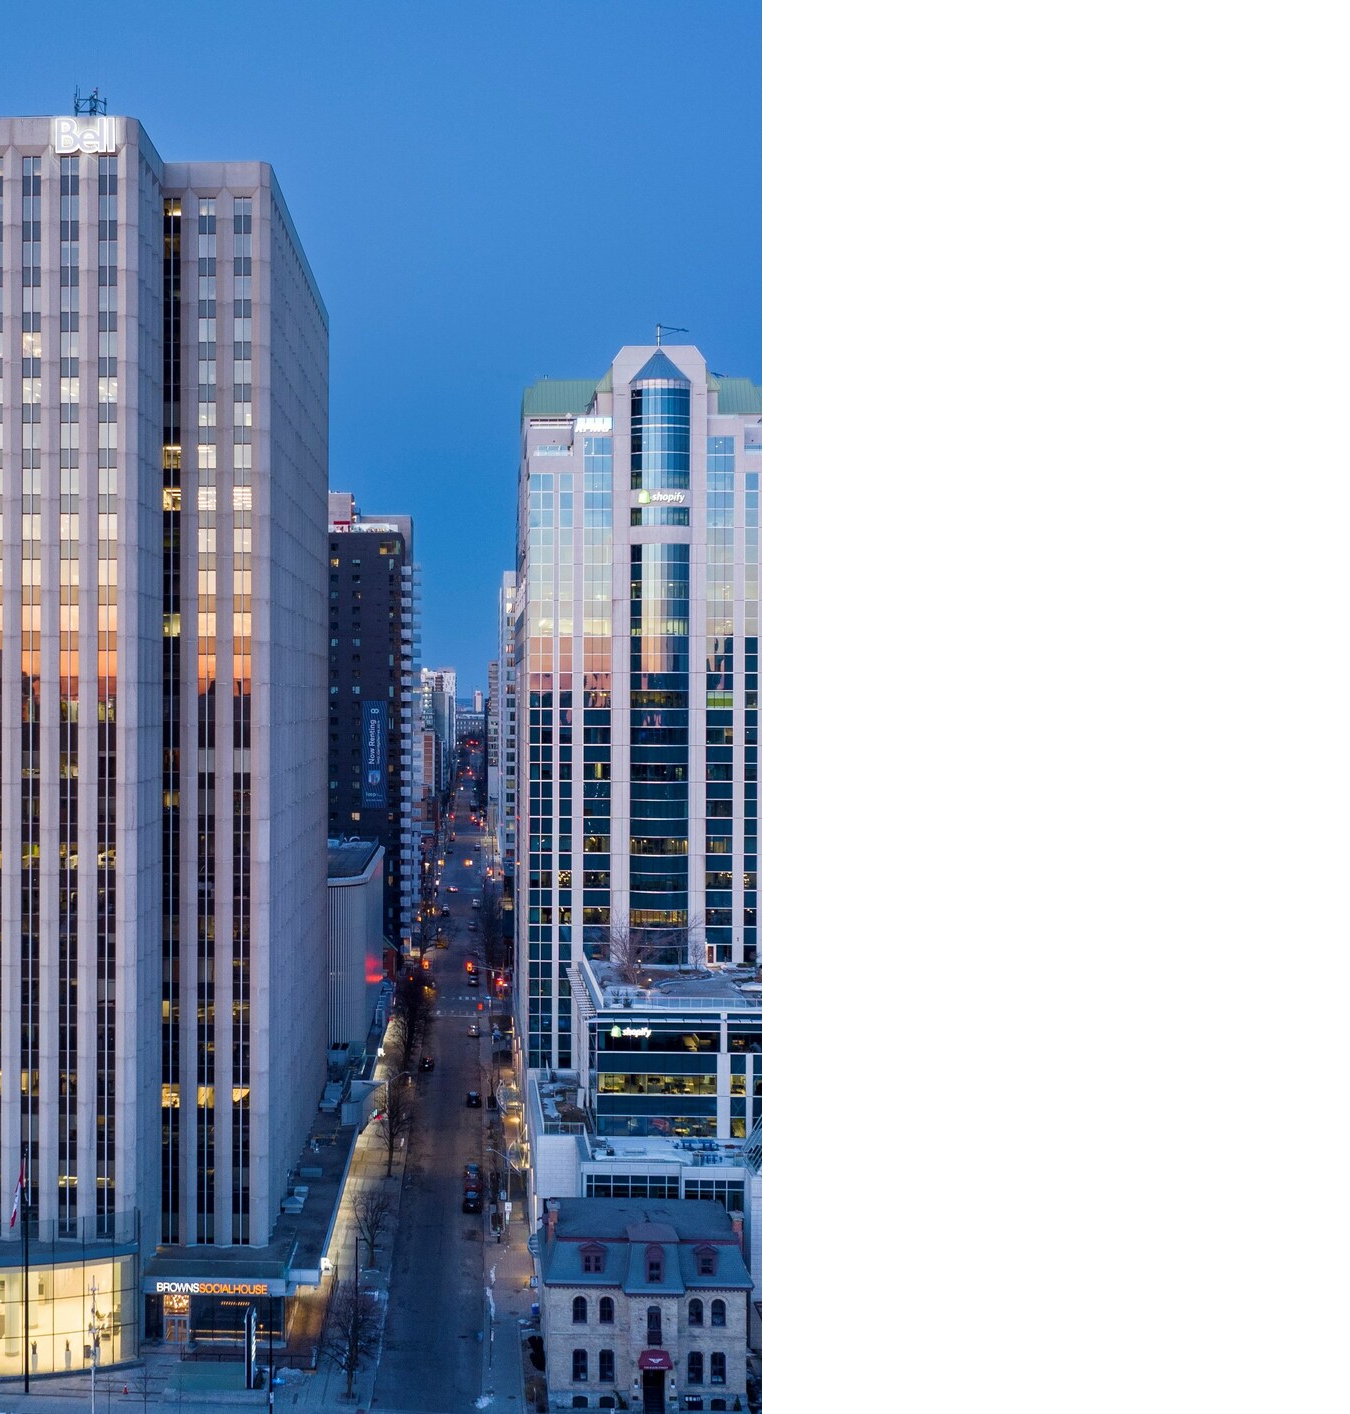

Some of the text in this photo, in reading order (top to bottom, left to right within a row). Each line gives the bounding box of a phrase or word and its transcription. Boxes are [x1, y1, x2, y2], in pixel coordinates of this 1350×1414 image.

[55, 117, 116, 153] Bell
[651, 491, 686, 504] shopify
[368, 719, 376, 765] Now Renting
[622, 1026, 652, 1038] shopify
